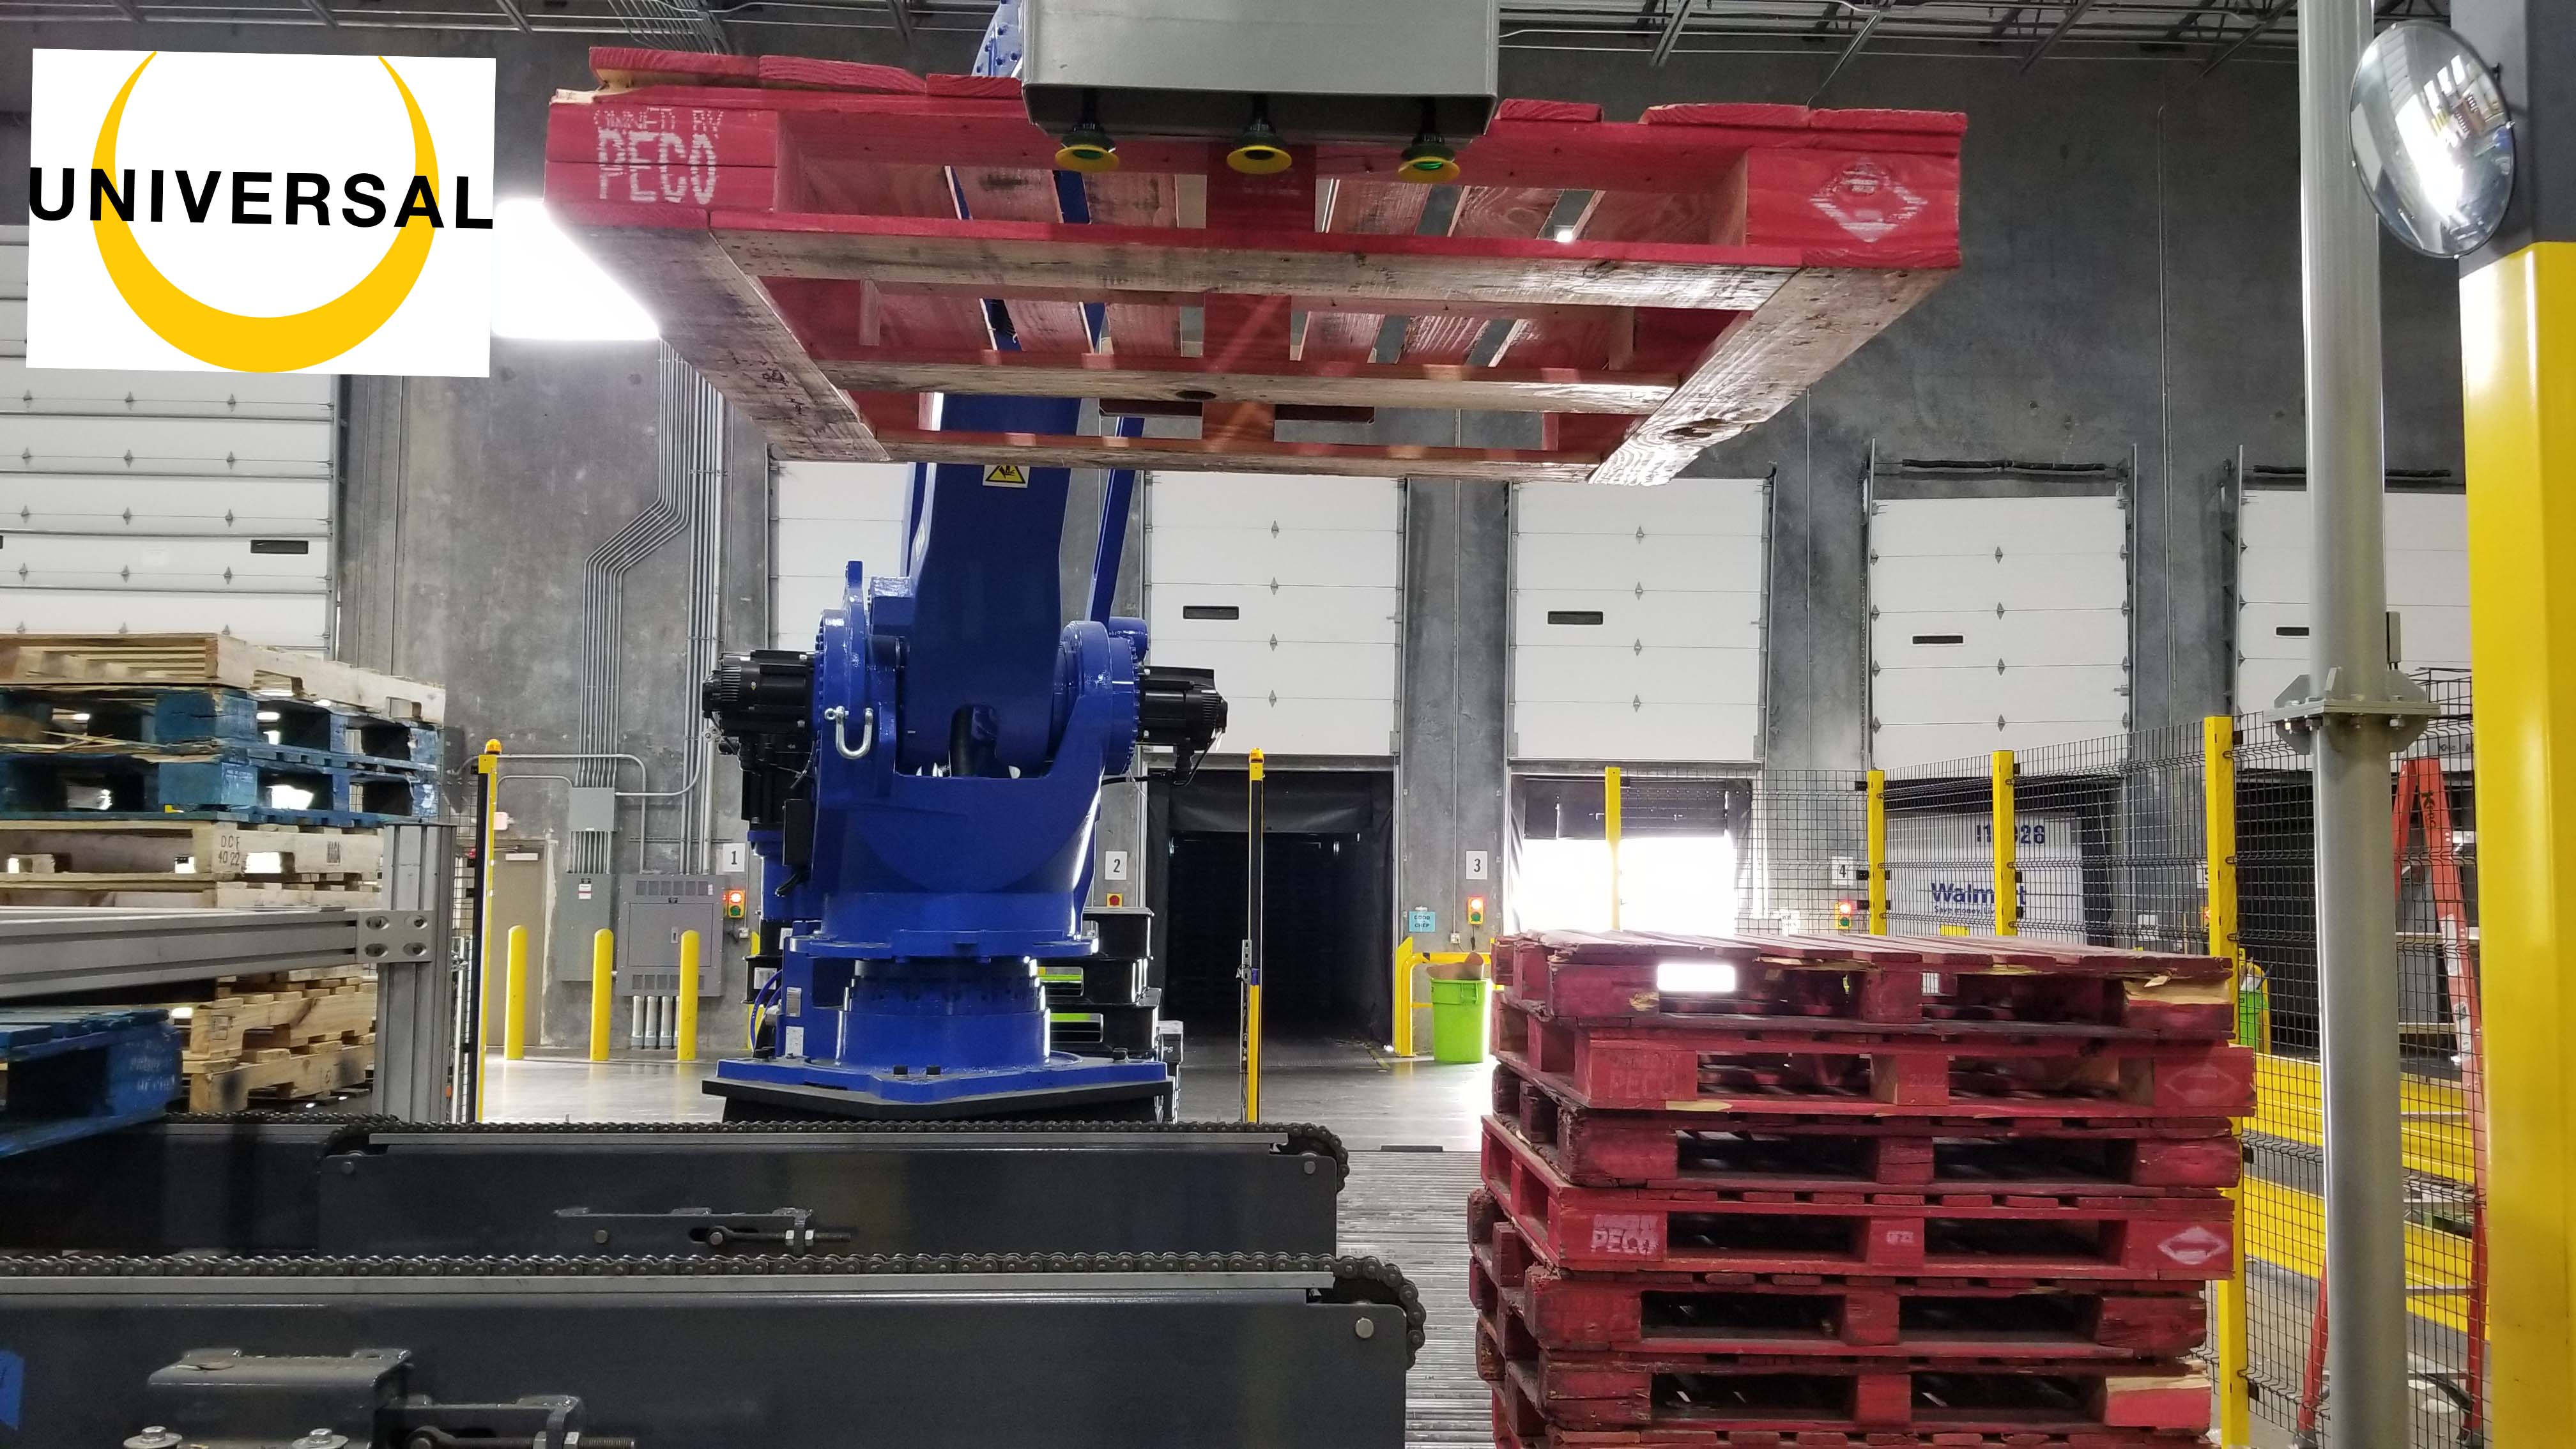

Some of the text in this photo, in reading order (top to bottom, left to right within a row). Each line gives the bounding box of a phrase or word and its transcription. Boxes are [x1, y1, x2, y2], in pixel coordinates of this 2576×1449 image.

[597, 127, 717, 204] PECO
[221, 835, 240, 850] DCF
[732, 850, 738, 865] 1
[1113, 859, 1121, 873] 2
[1473, 858, 1481, 873] 3
[1839, 864, 1847, 878] 4
[1931, 883, 2027, 905] Walmt
